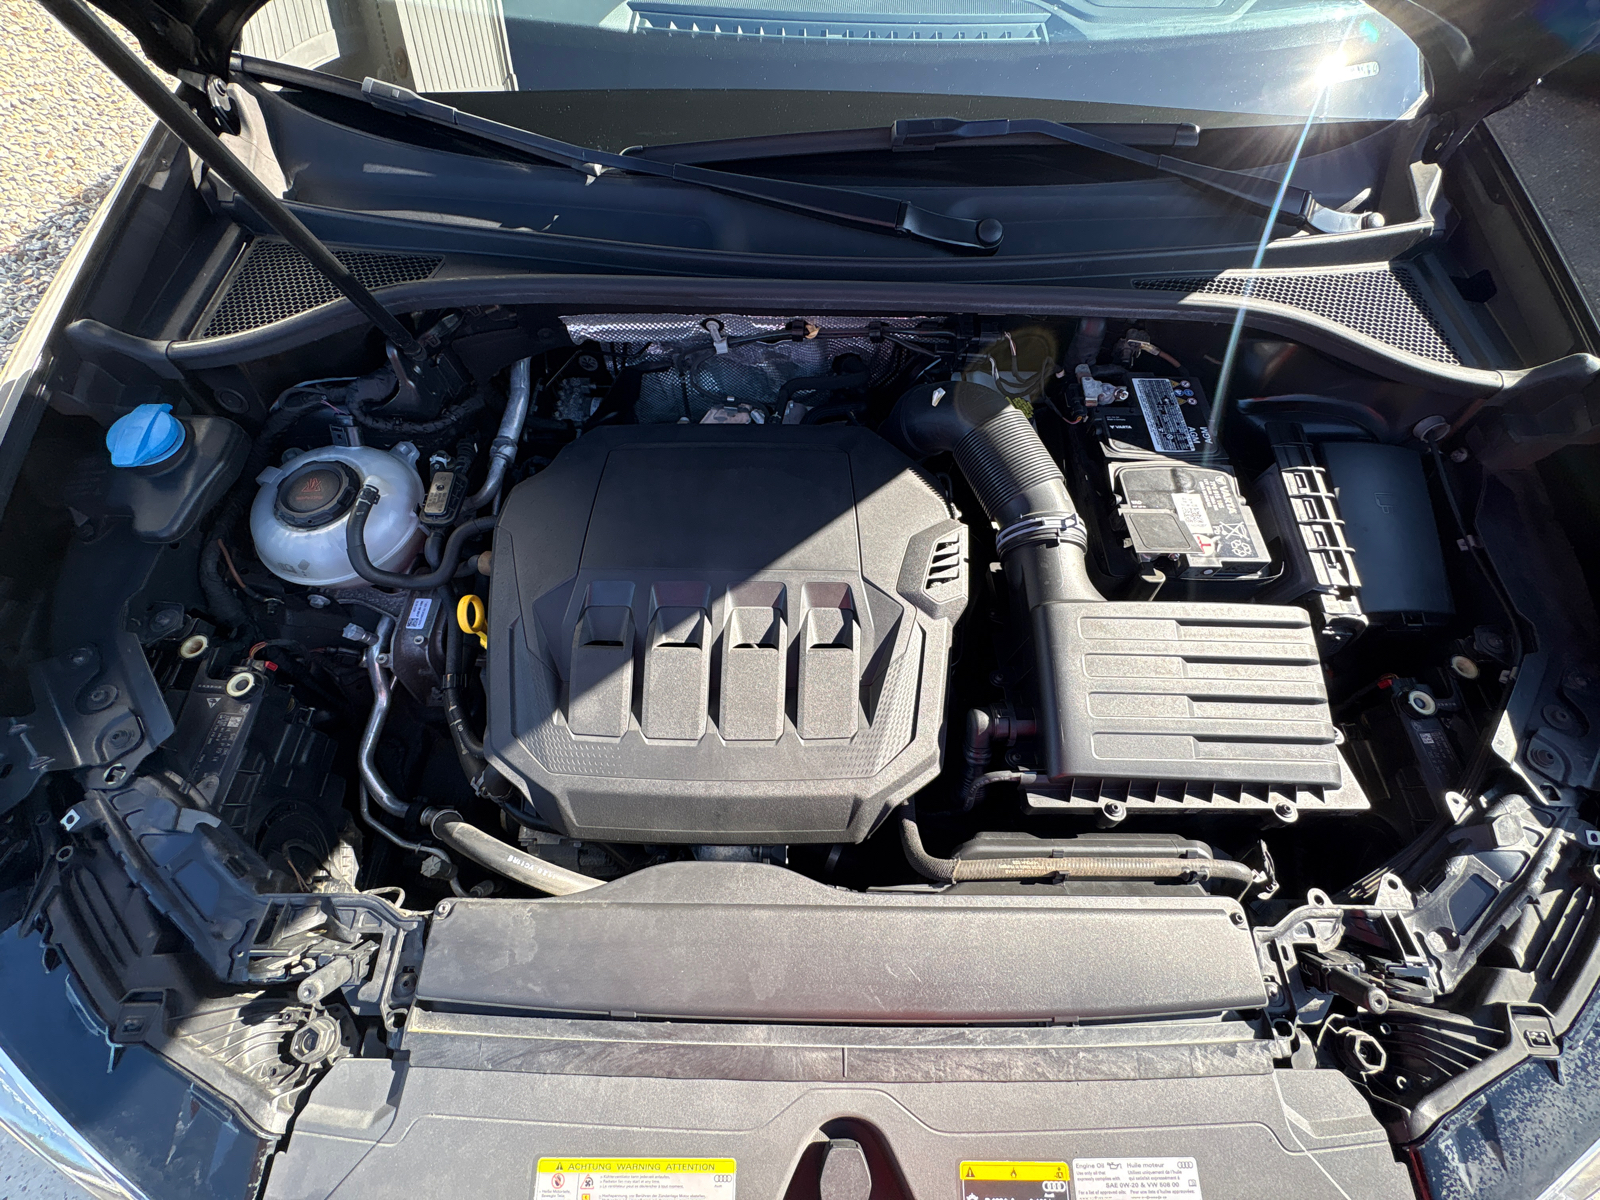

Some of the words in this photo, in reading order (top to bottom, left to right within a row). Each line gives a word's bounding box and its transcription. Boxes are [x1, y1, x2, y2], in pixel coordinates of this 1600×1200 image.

[1187, 426, 1201, 444] AGM
[1200, 426, 1213, 444] AGM
[1219, 485, 1238, 515] VARTA
[568, 1163, 611, 1171] ACHTUNG
[616, 1163, 661, 1171] WARNING
[665, 1163, 716, 1171] ATTENTION
